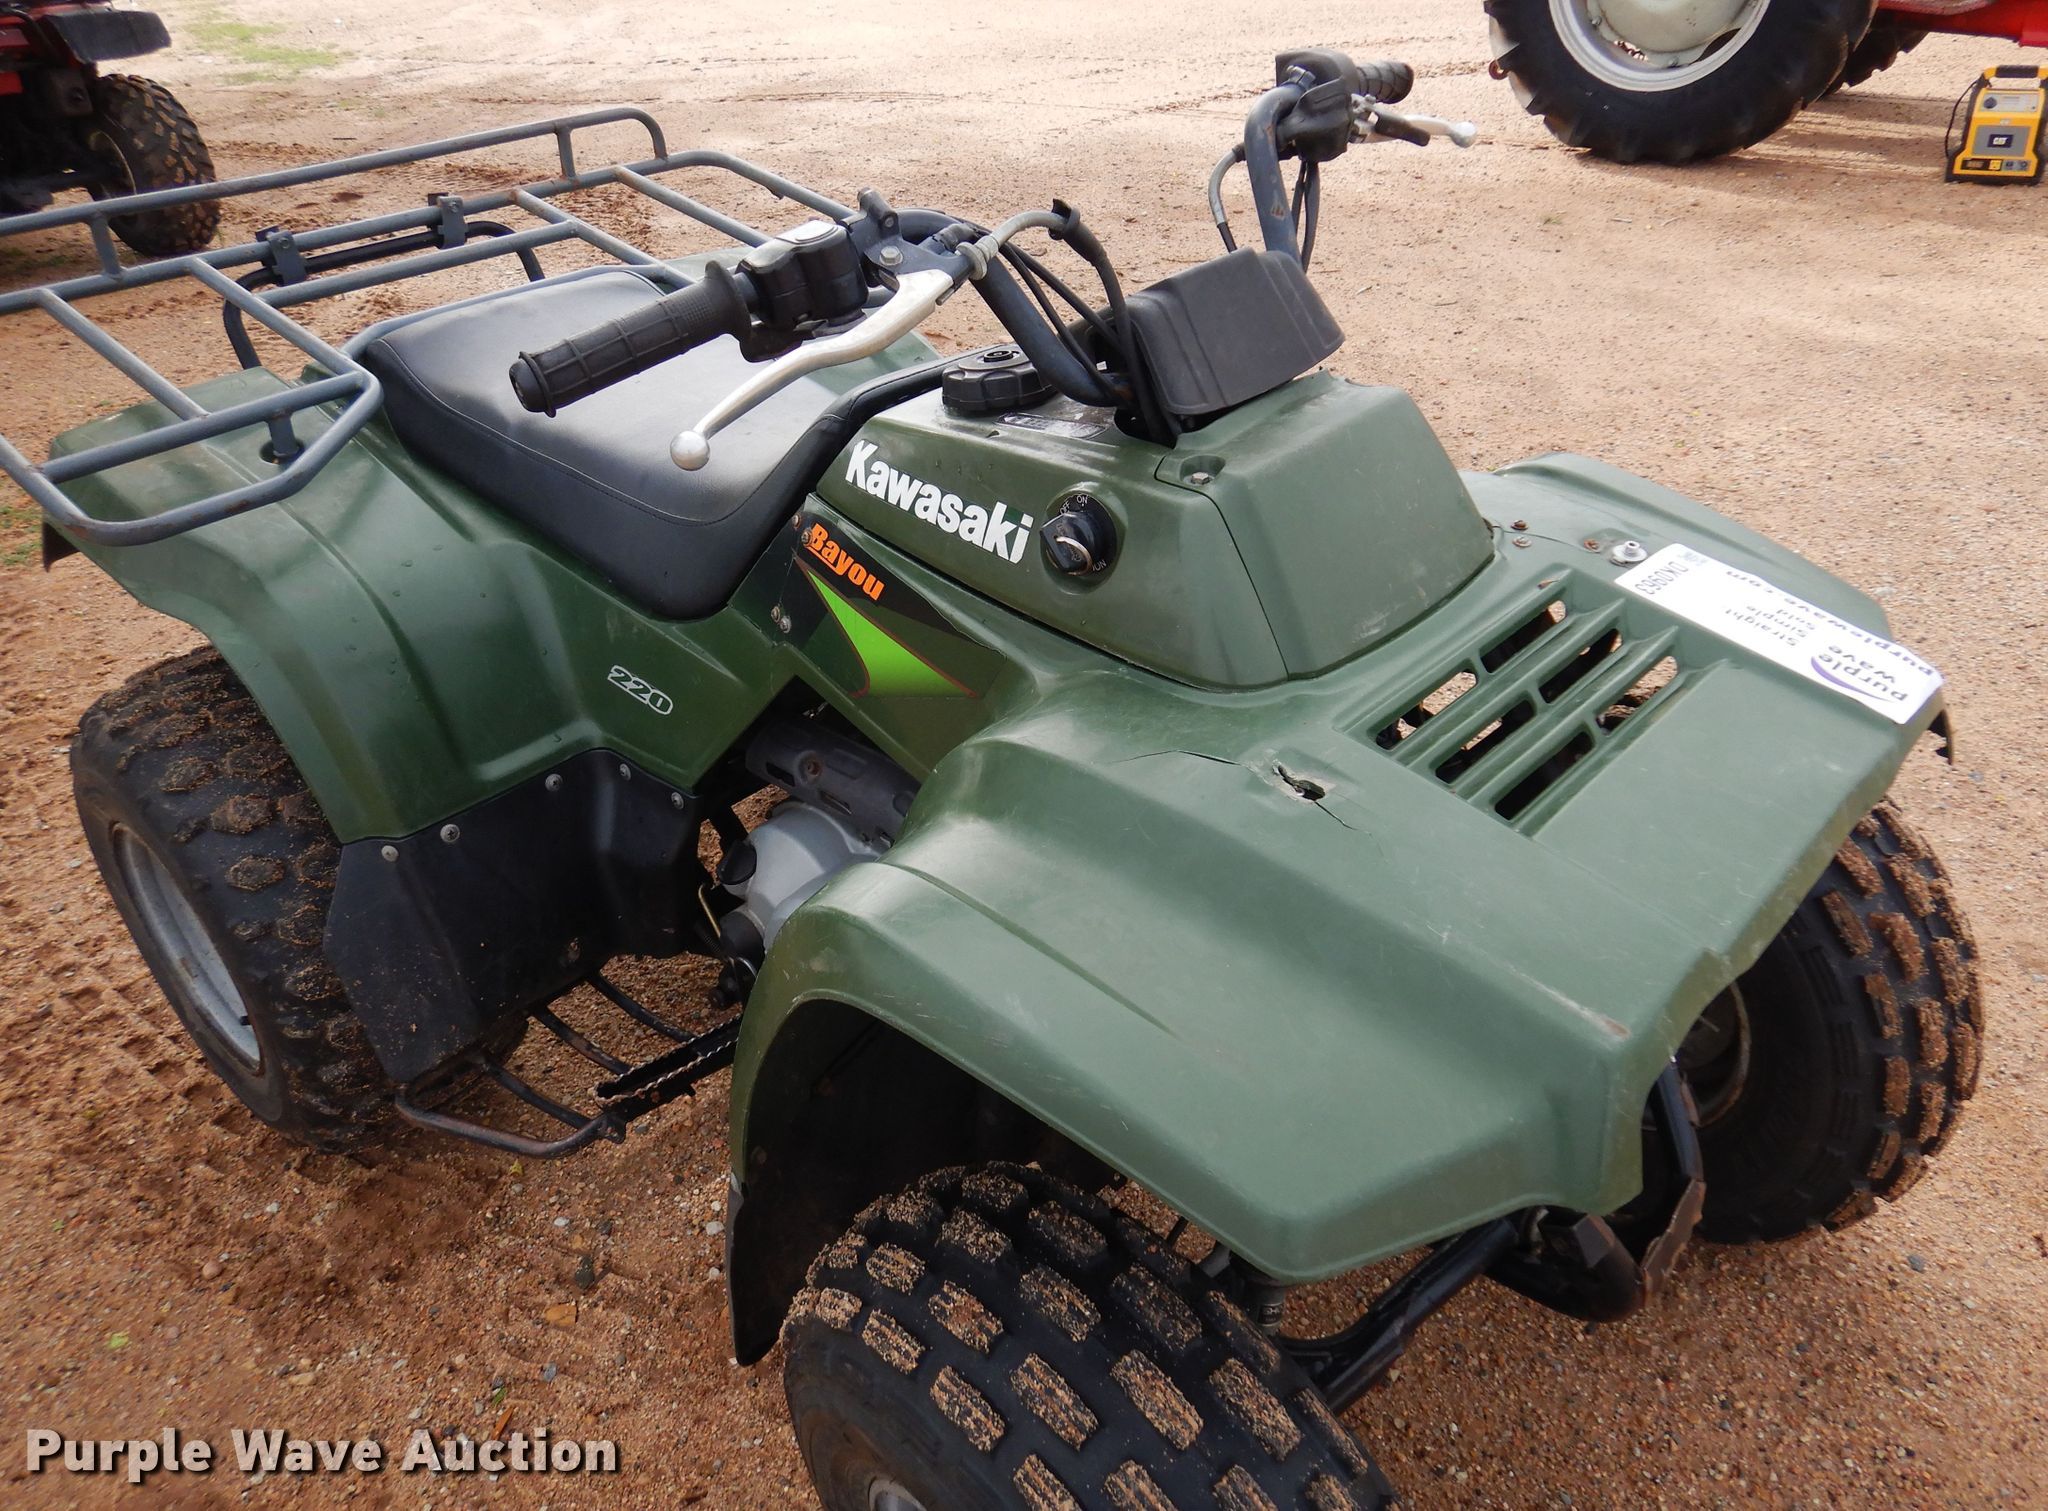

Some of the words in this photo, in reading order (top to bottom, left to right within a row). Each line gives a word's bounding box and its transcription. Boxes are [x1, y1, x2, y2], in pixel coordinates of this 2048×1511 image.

[844, 439, 1034, 564] Kawasaki
[1059, 501, 1070, 515] OFF
[1076, 495, 1088, 505] ON
[809, 522, 885, 601] Bayou
[1818, 653, 1909, 702] purple
[1828, 644, 1896, 684] wave
[607, 664, 673, 715] 220
